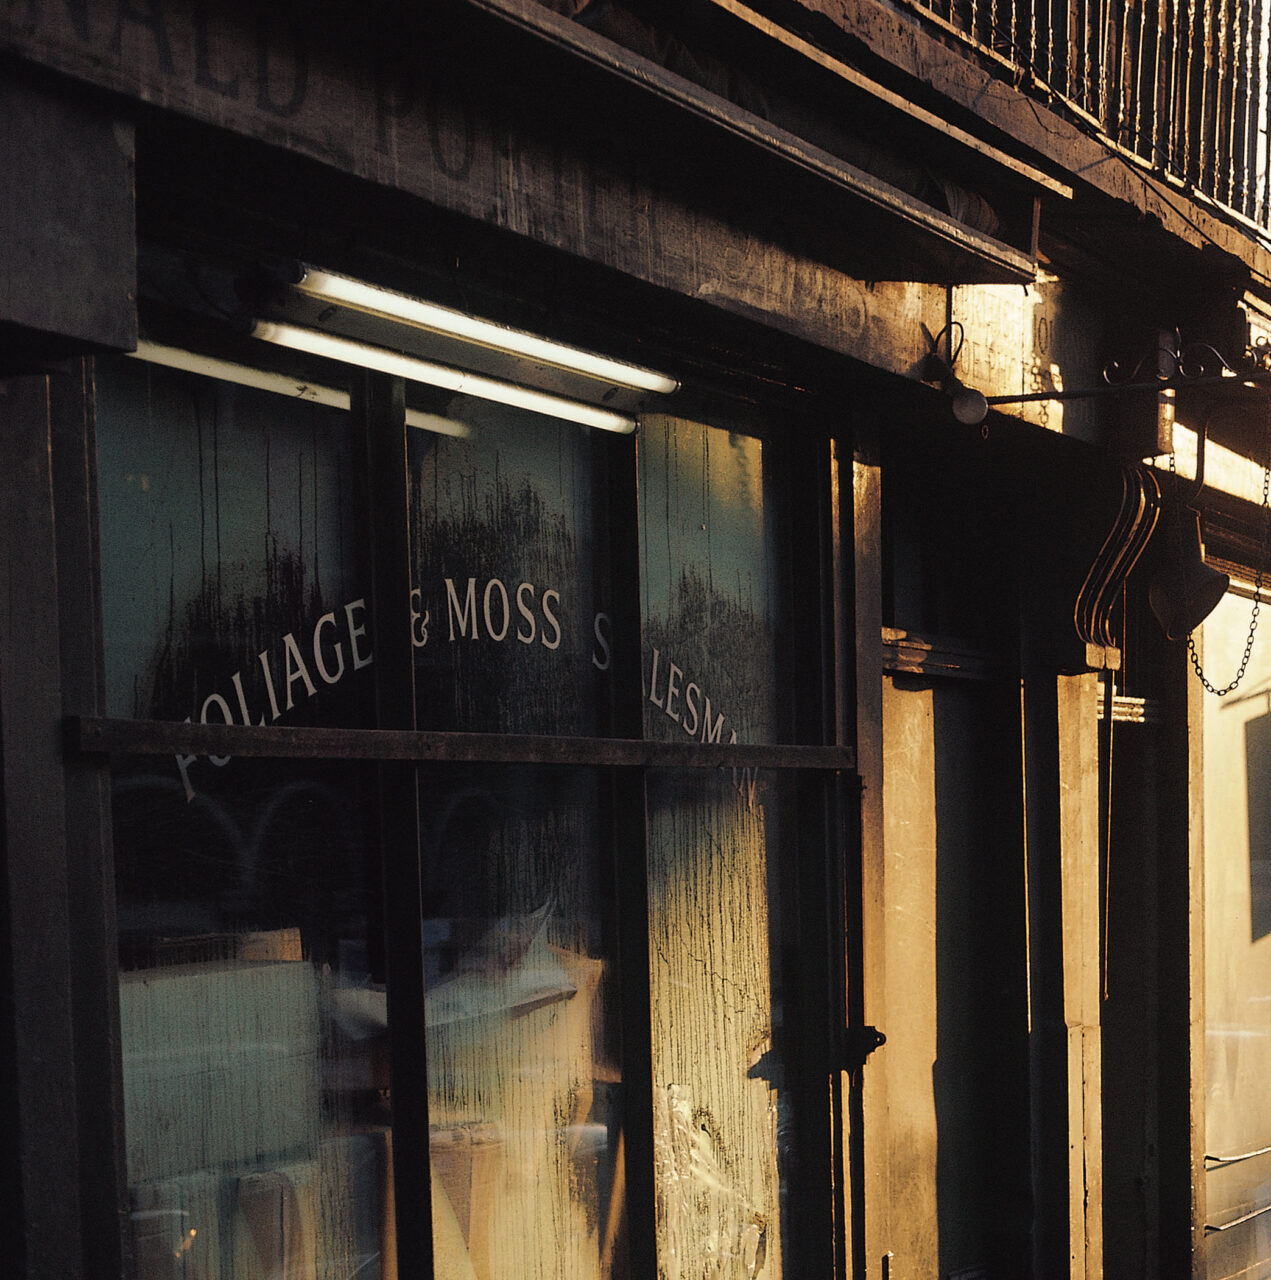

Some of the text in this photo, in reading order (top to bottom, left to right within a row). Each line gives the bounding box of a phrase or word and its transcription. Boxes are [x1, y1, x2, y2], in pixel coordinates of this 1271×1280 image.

[175, 598, 374, 803] FOLIAGE
[444, 577, 561, 650] MOSS
[592, 612, 758, 810] SLESMN
